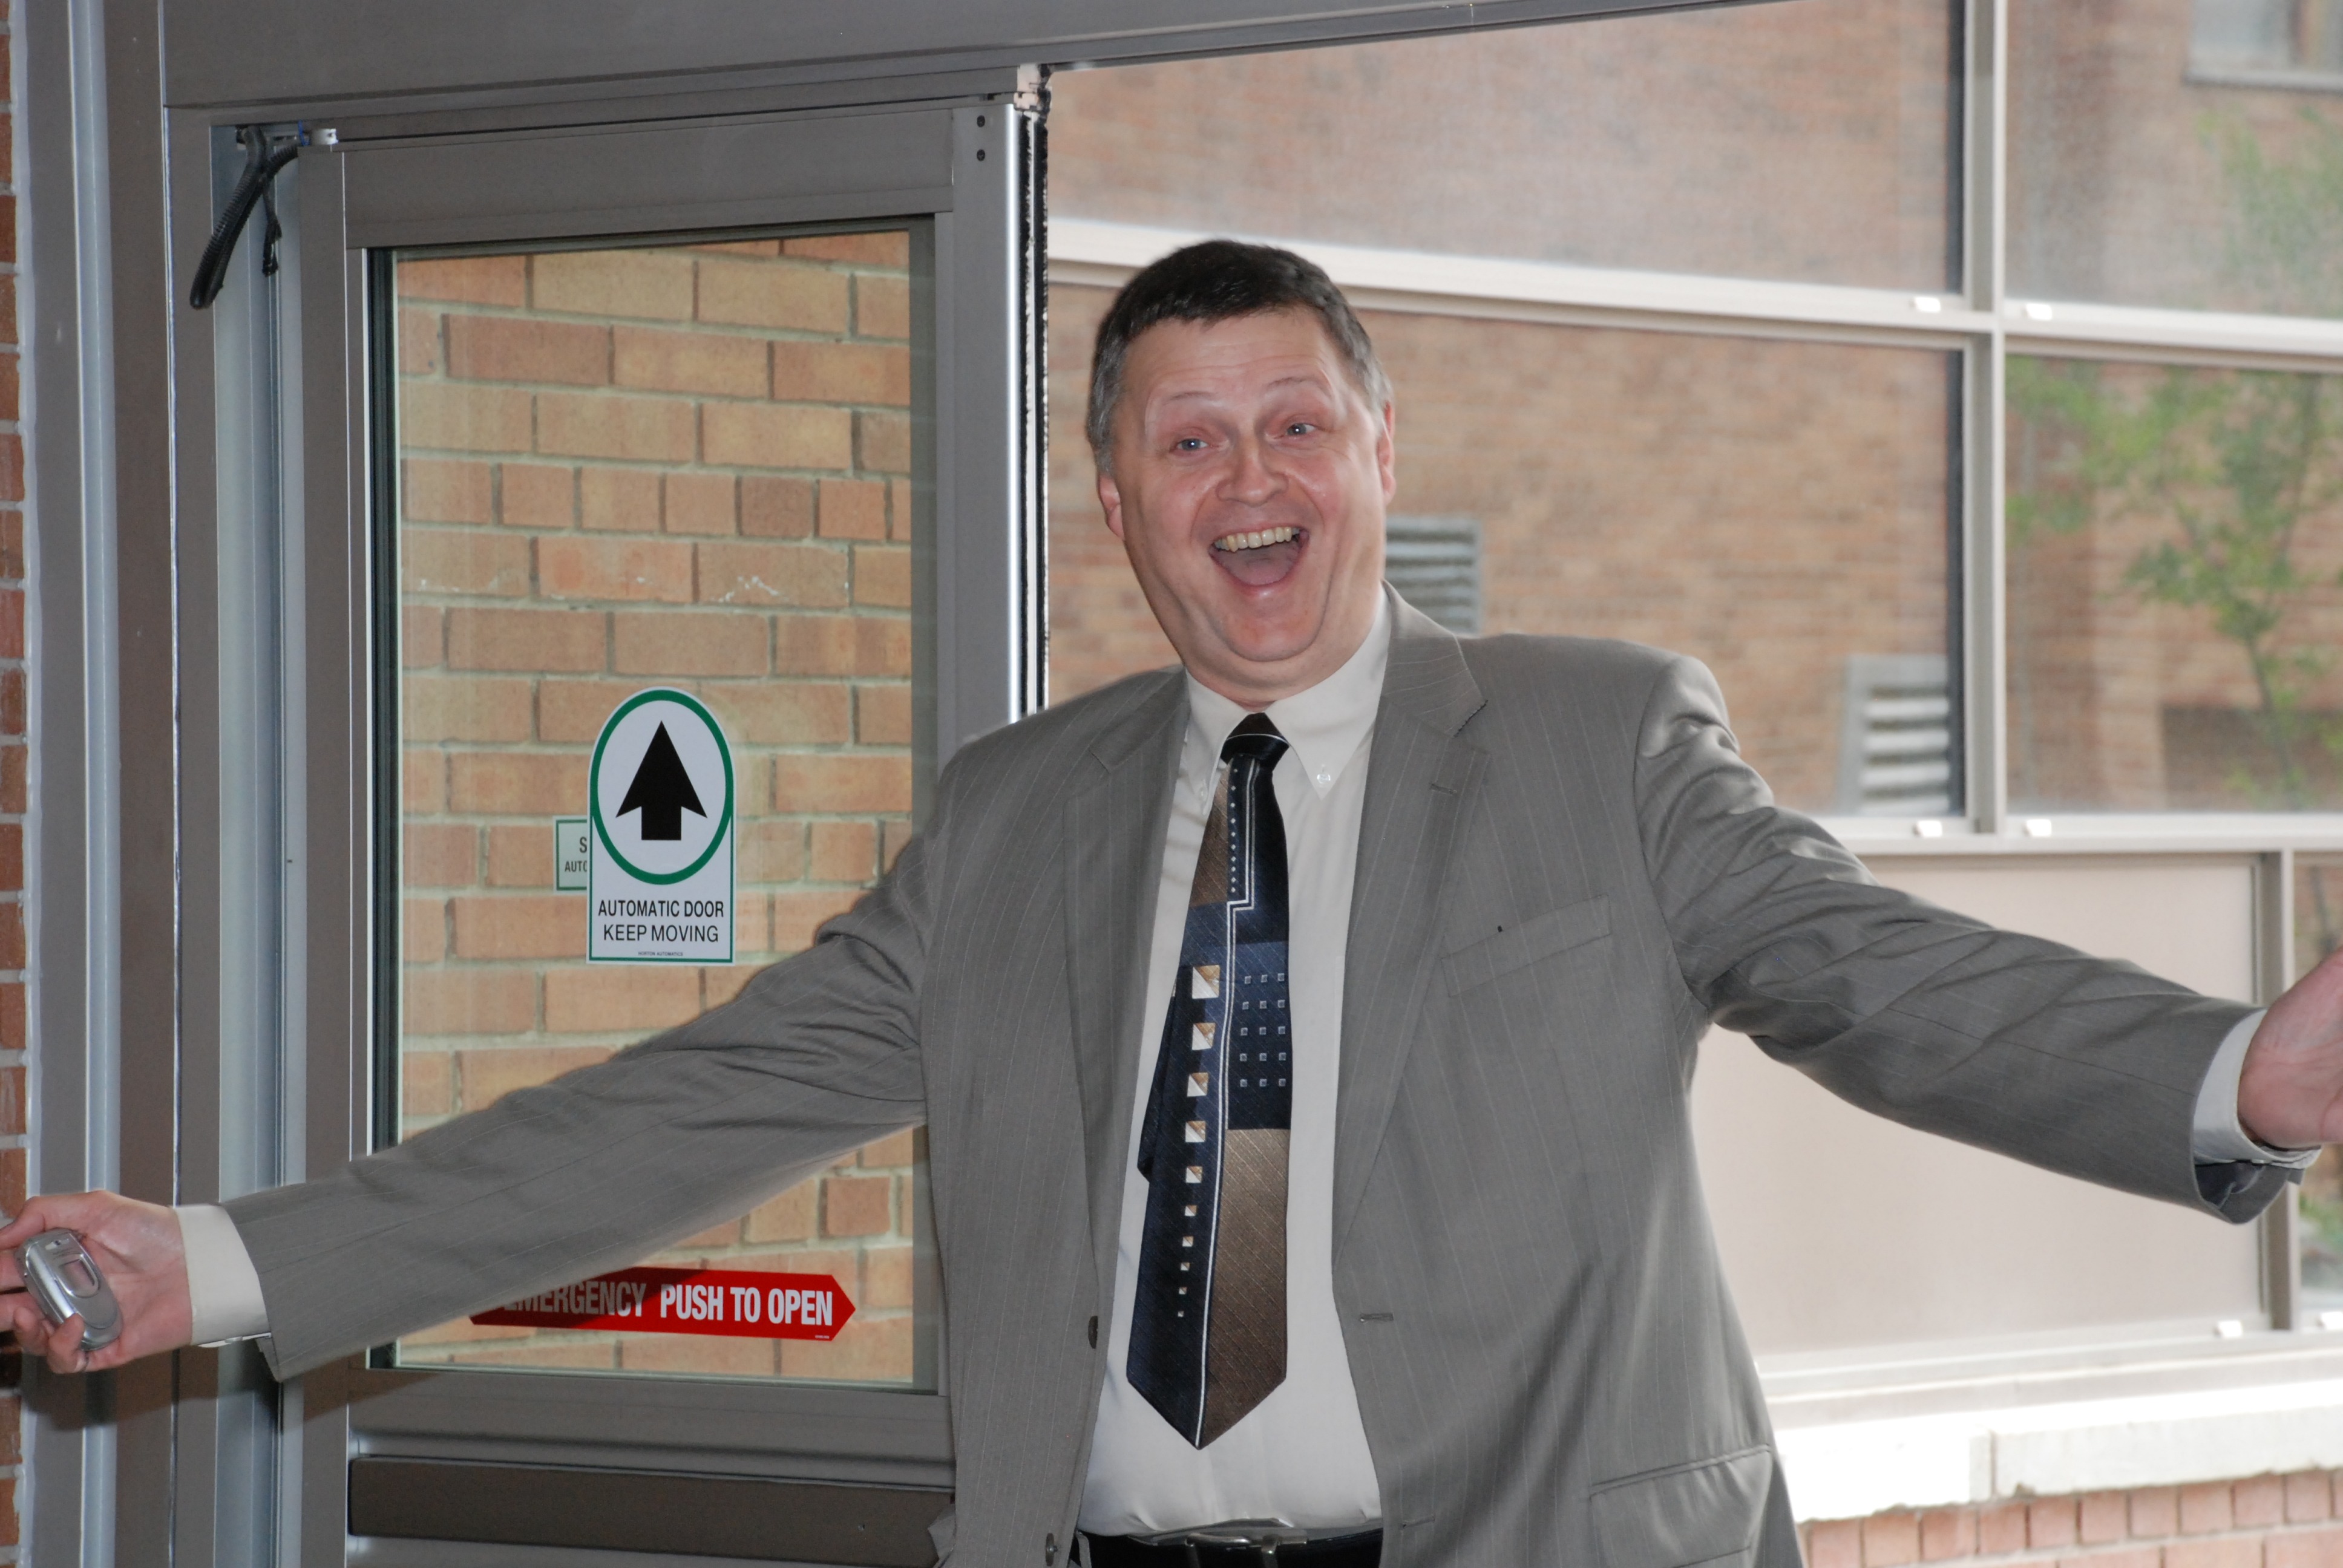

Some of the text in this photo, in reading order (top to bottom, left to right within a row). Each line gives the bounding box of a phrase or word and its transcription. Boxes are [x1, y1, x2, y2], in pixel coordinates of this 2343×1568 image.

[598, 900, 724, 918] AUTOMATIC DOOR
[603, 924, 718, 942] KEEP MOVING
[661, 1284, 724, 1321] PUSH
[730, 1287, 761, 1323] TO
[768, 1288, 833, 1326] OPEN
